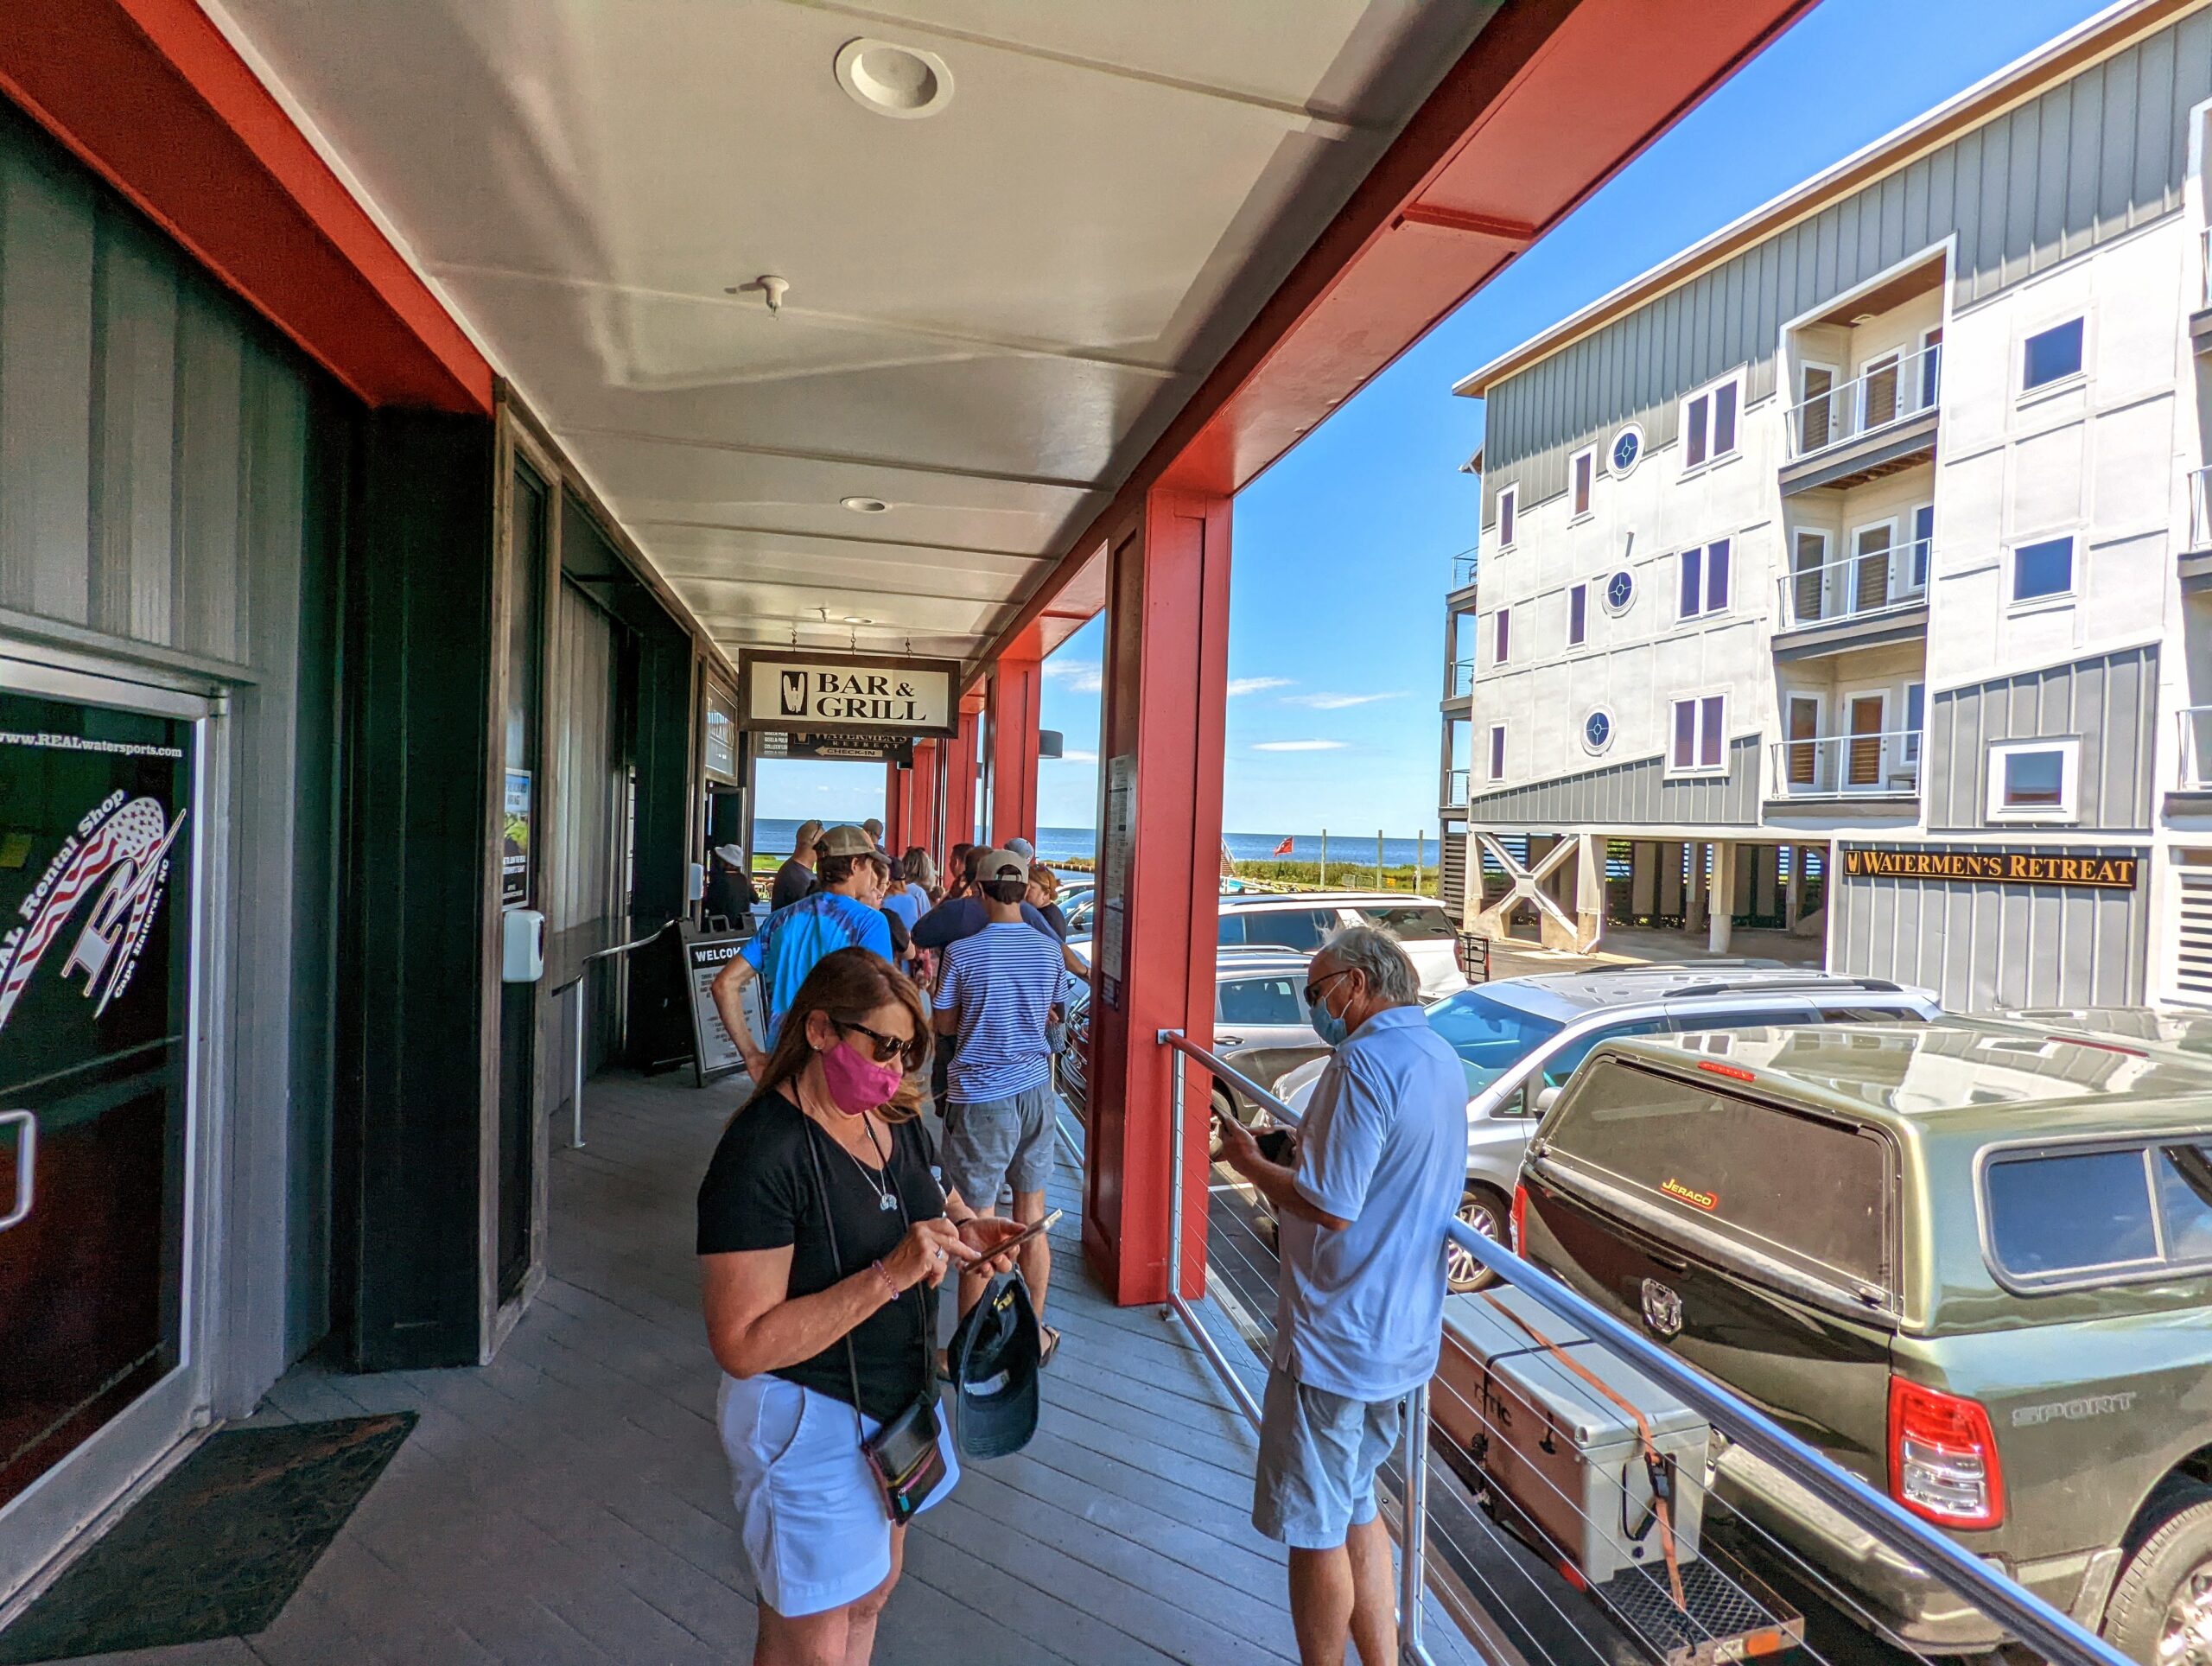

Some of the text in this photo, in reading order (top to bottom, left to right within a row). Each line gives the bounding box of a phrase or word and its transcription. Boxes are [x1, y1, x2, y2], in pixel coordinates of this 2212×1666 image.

[817, 673, 914, 696] BAR &
[817, 697, 926, 721] GRILL
[832, 741, 899, 749] RETREAT
[18, 836, 79, 921] Rental
[78, 789, 124, 838] Shop
[1862, 852, 2133, 881] WATERMEN'S RETREAT
[114, 961, 136, 998] Cape
[158, 859, 169, 882] NC
[1662, 1179, 1712, 1205] JERACO
[2012, 1392, 2137, 1426] SPORT
